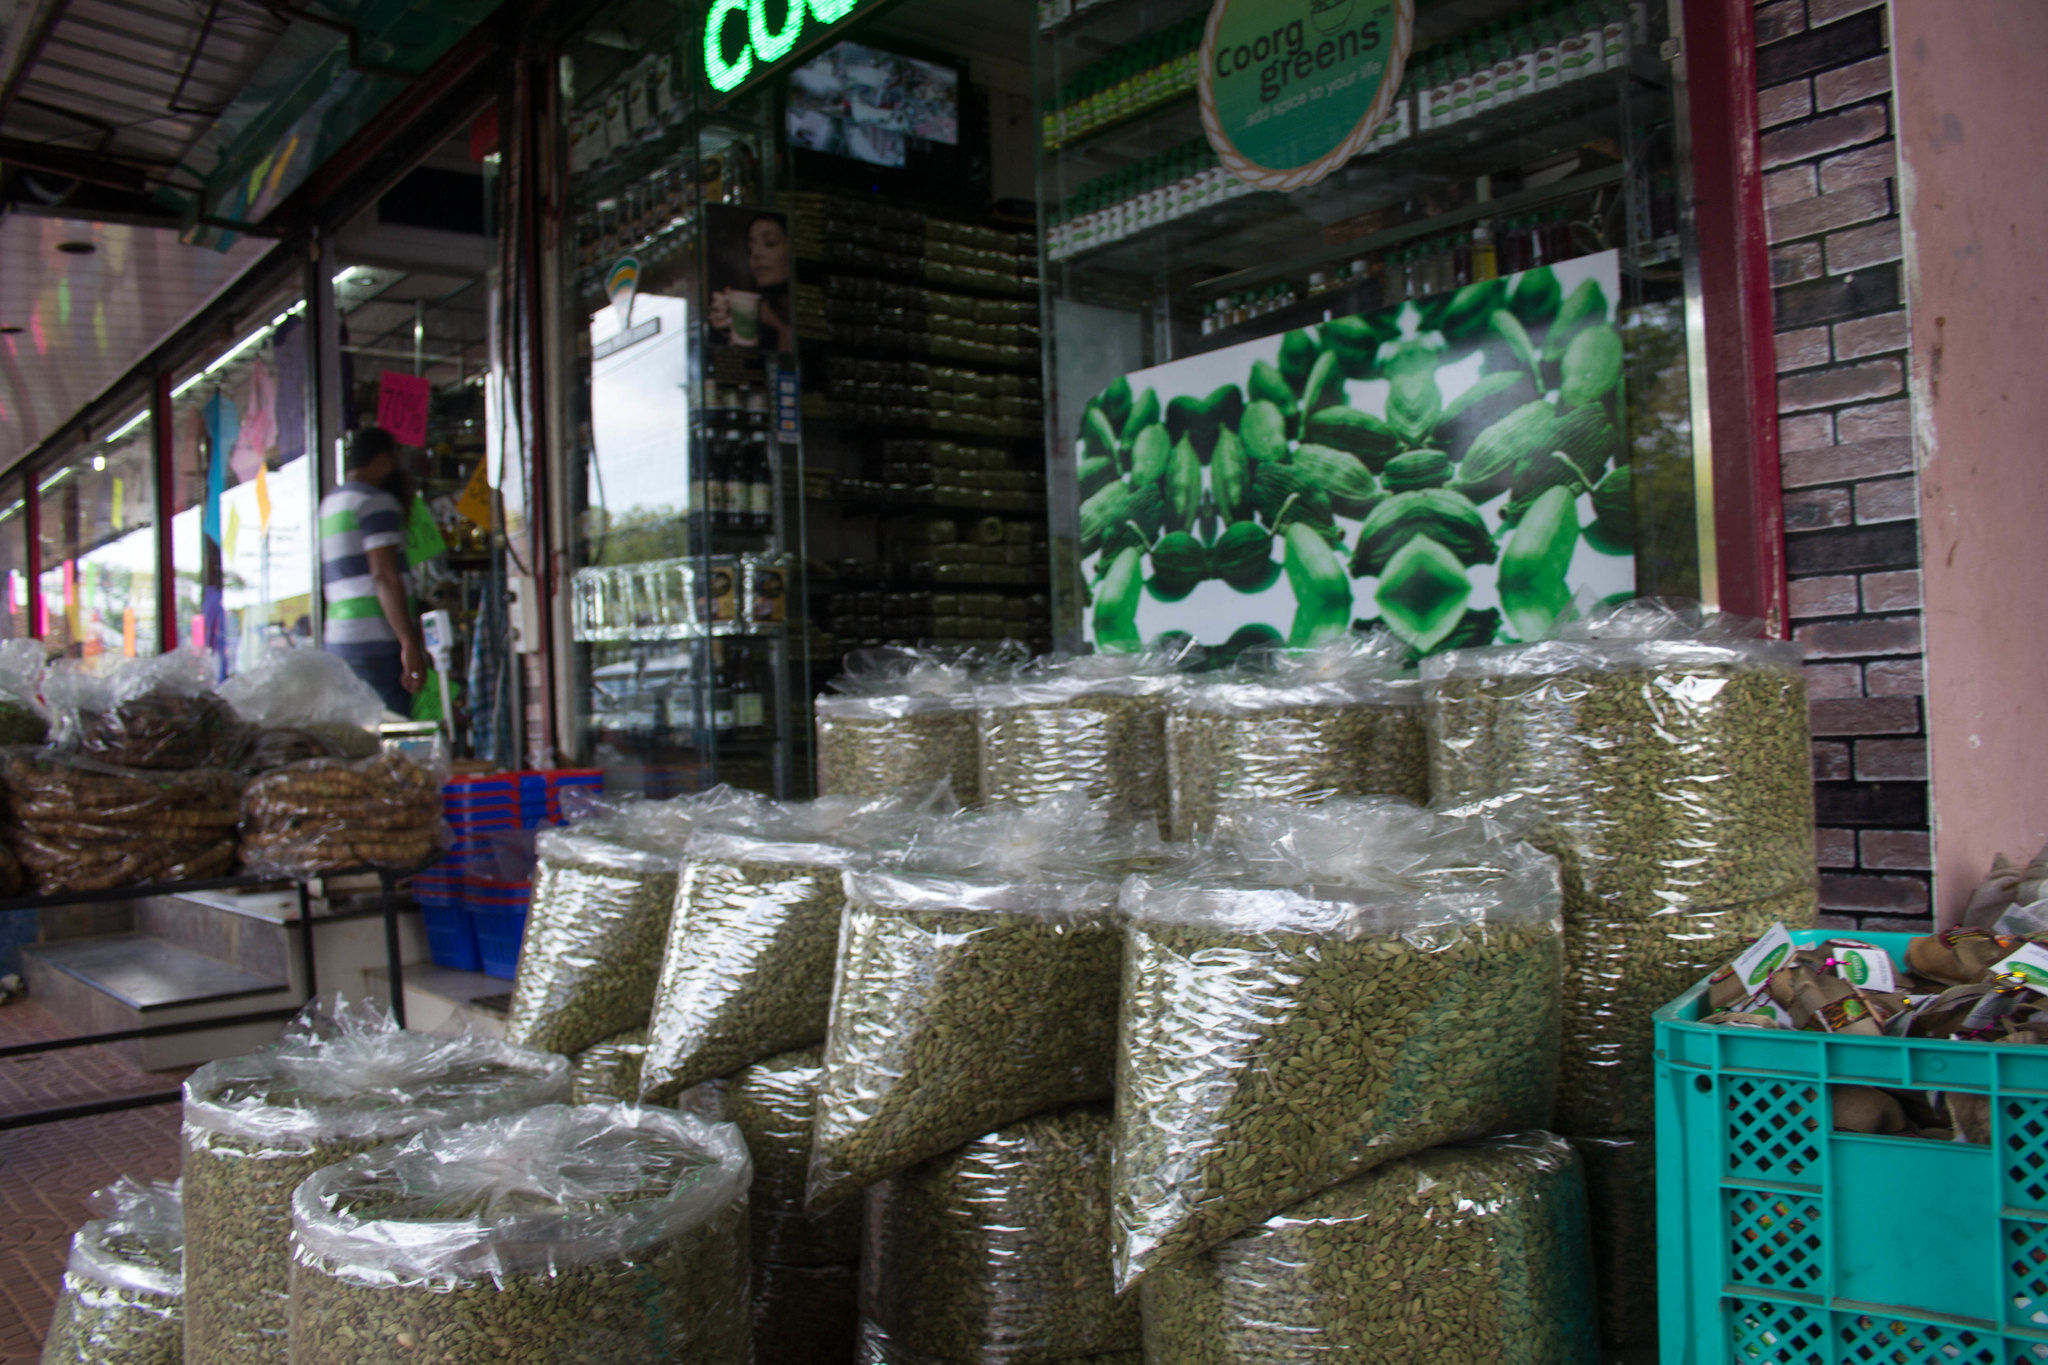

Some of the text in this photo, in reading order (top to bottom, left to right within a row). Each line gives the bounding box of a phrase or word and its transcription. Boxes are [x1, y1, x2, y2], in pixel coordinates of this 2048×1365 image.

[1259, 21, 1380, 102] greens
[1309, 85, 1324, 101] to
[1326, 71, 1358, 98] your
[1359, 61, 1383, 80] life
